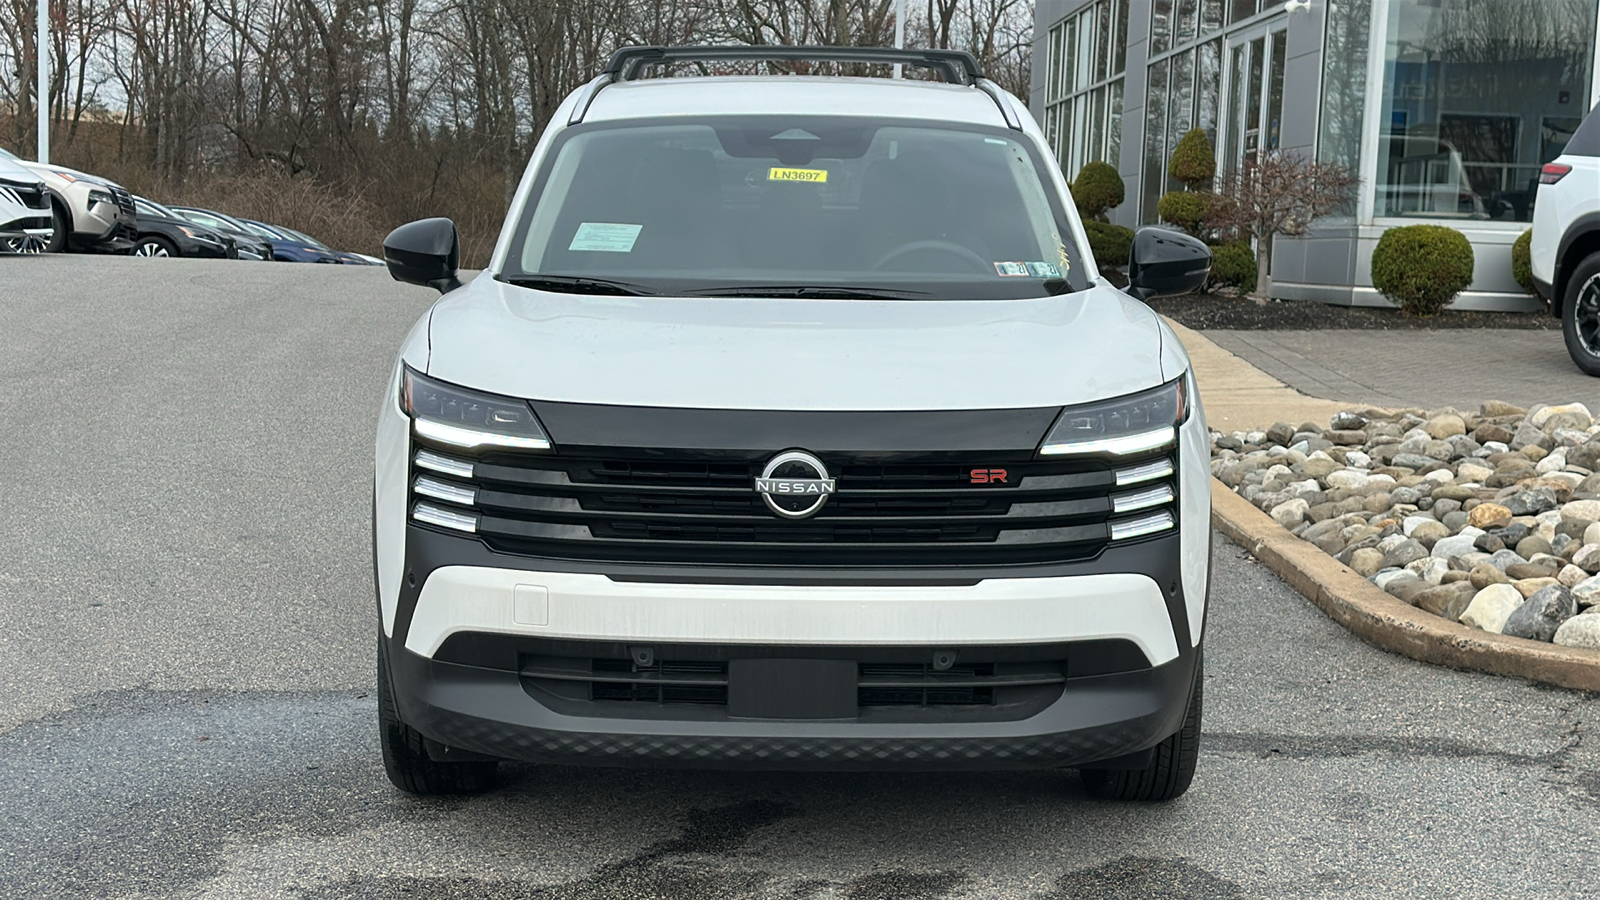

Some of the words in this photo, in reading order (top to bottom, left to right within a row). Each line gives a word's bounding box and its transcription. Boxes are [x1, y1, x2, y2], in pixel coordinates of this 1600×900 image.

[774, 171, 820, 180] LN3697
[970, 469, 1008, 483] SR
[757, 481, 834, 493] NISSAN
